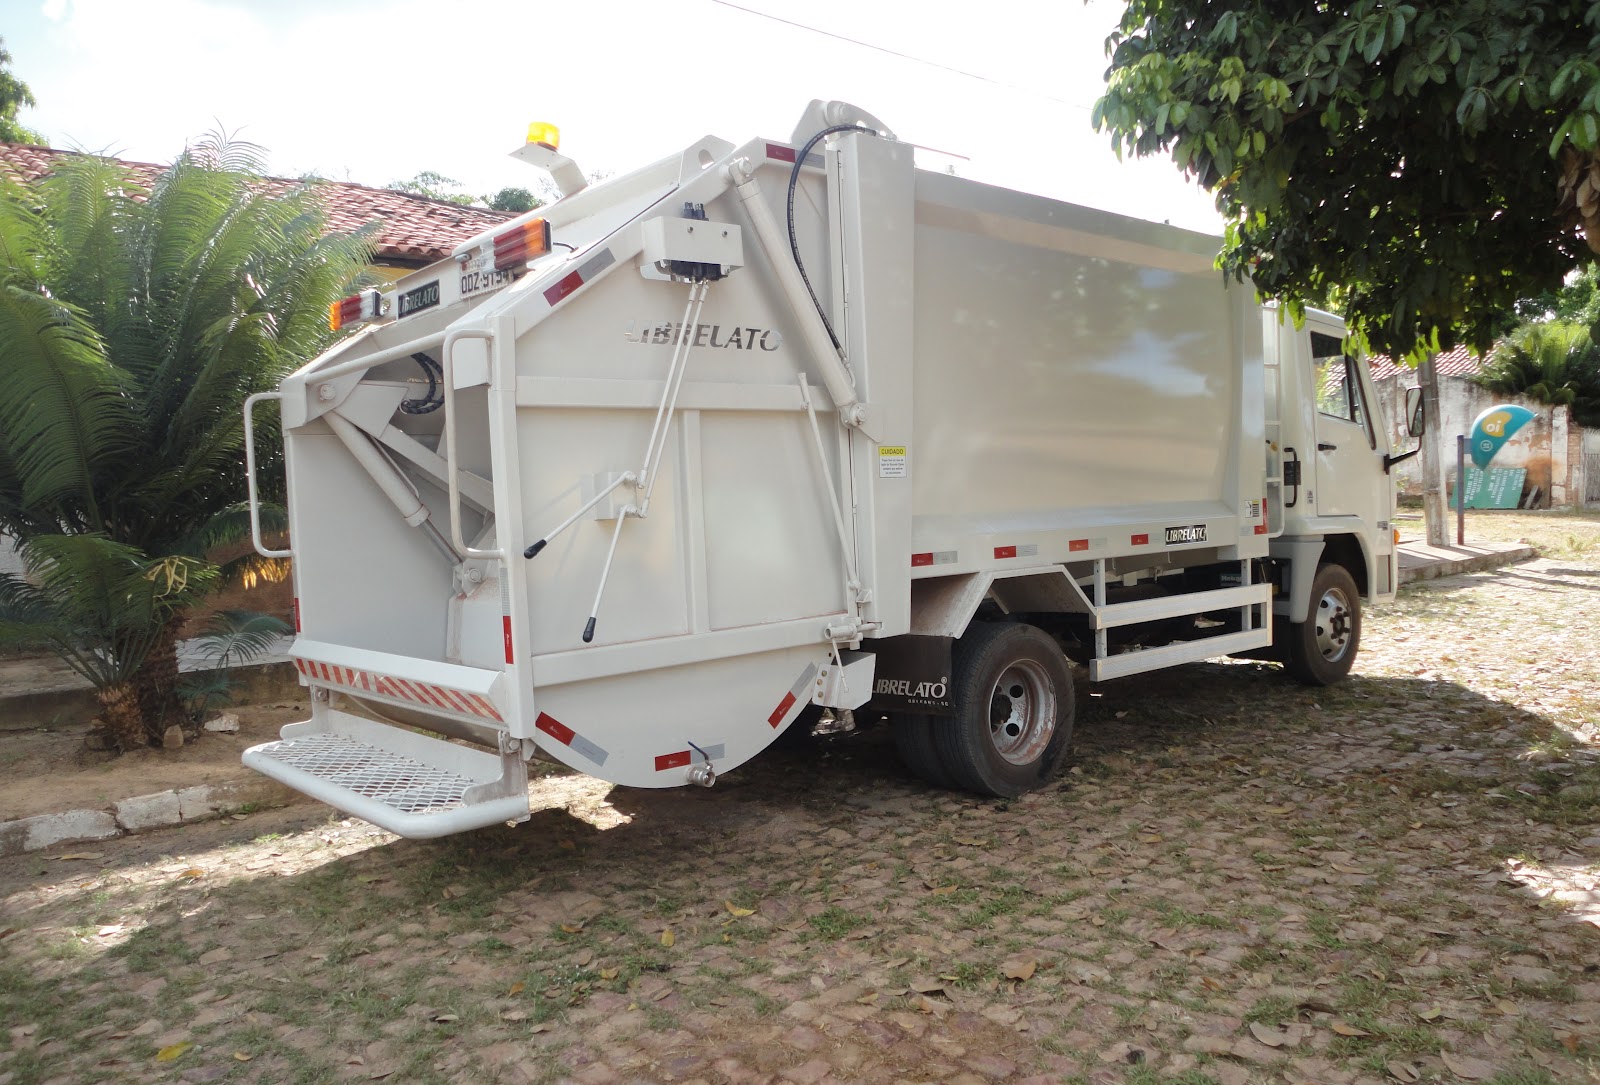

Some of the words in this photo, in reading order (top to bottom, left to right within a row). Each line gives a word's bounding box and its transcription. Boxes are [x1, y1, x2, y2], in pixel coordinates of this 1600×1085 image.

[398, 285, 439, 314] LIBRELATO
[625, 319, 783, 352] LIBRELATO
[1165, 527, 1206, 542] LIBRELATO
[872, 679, 947, 698] IBRELATO
